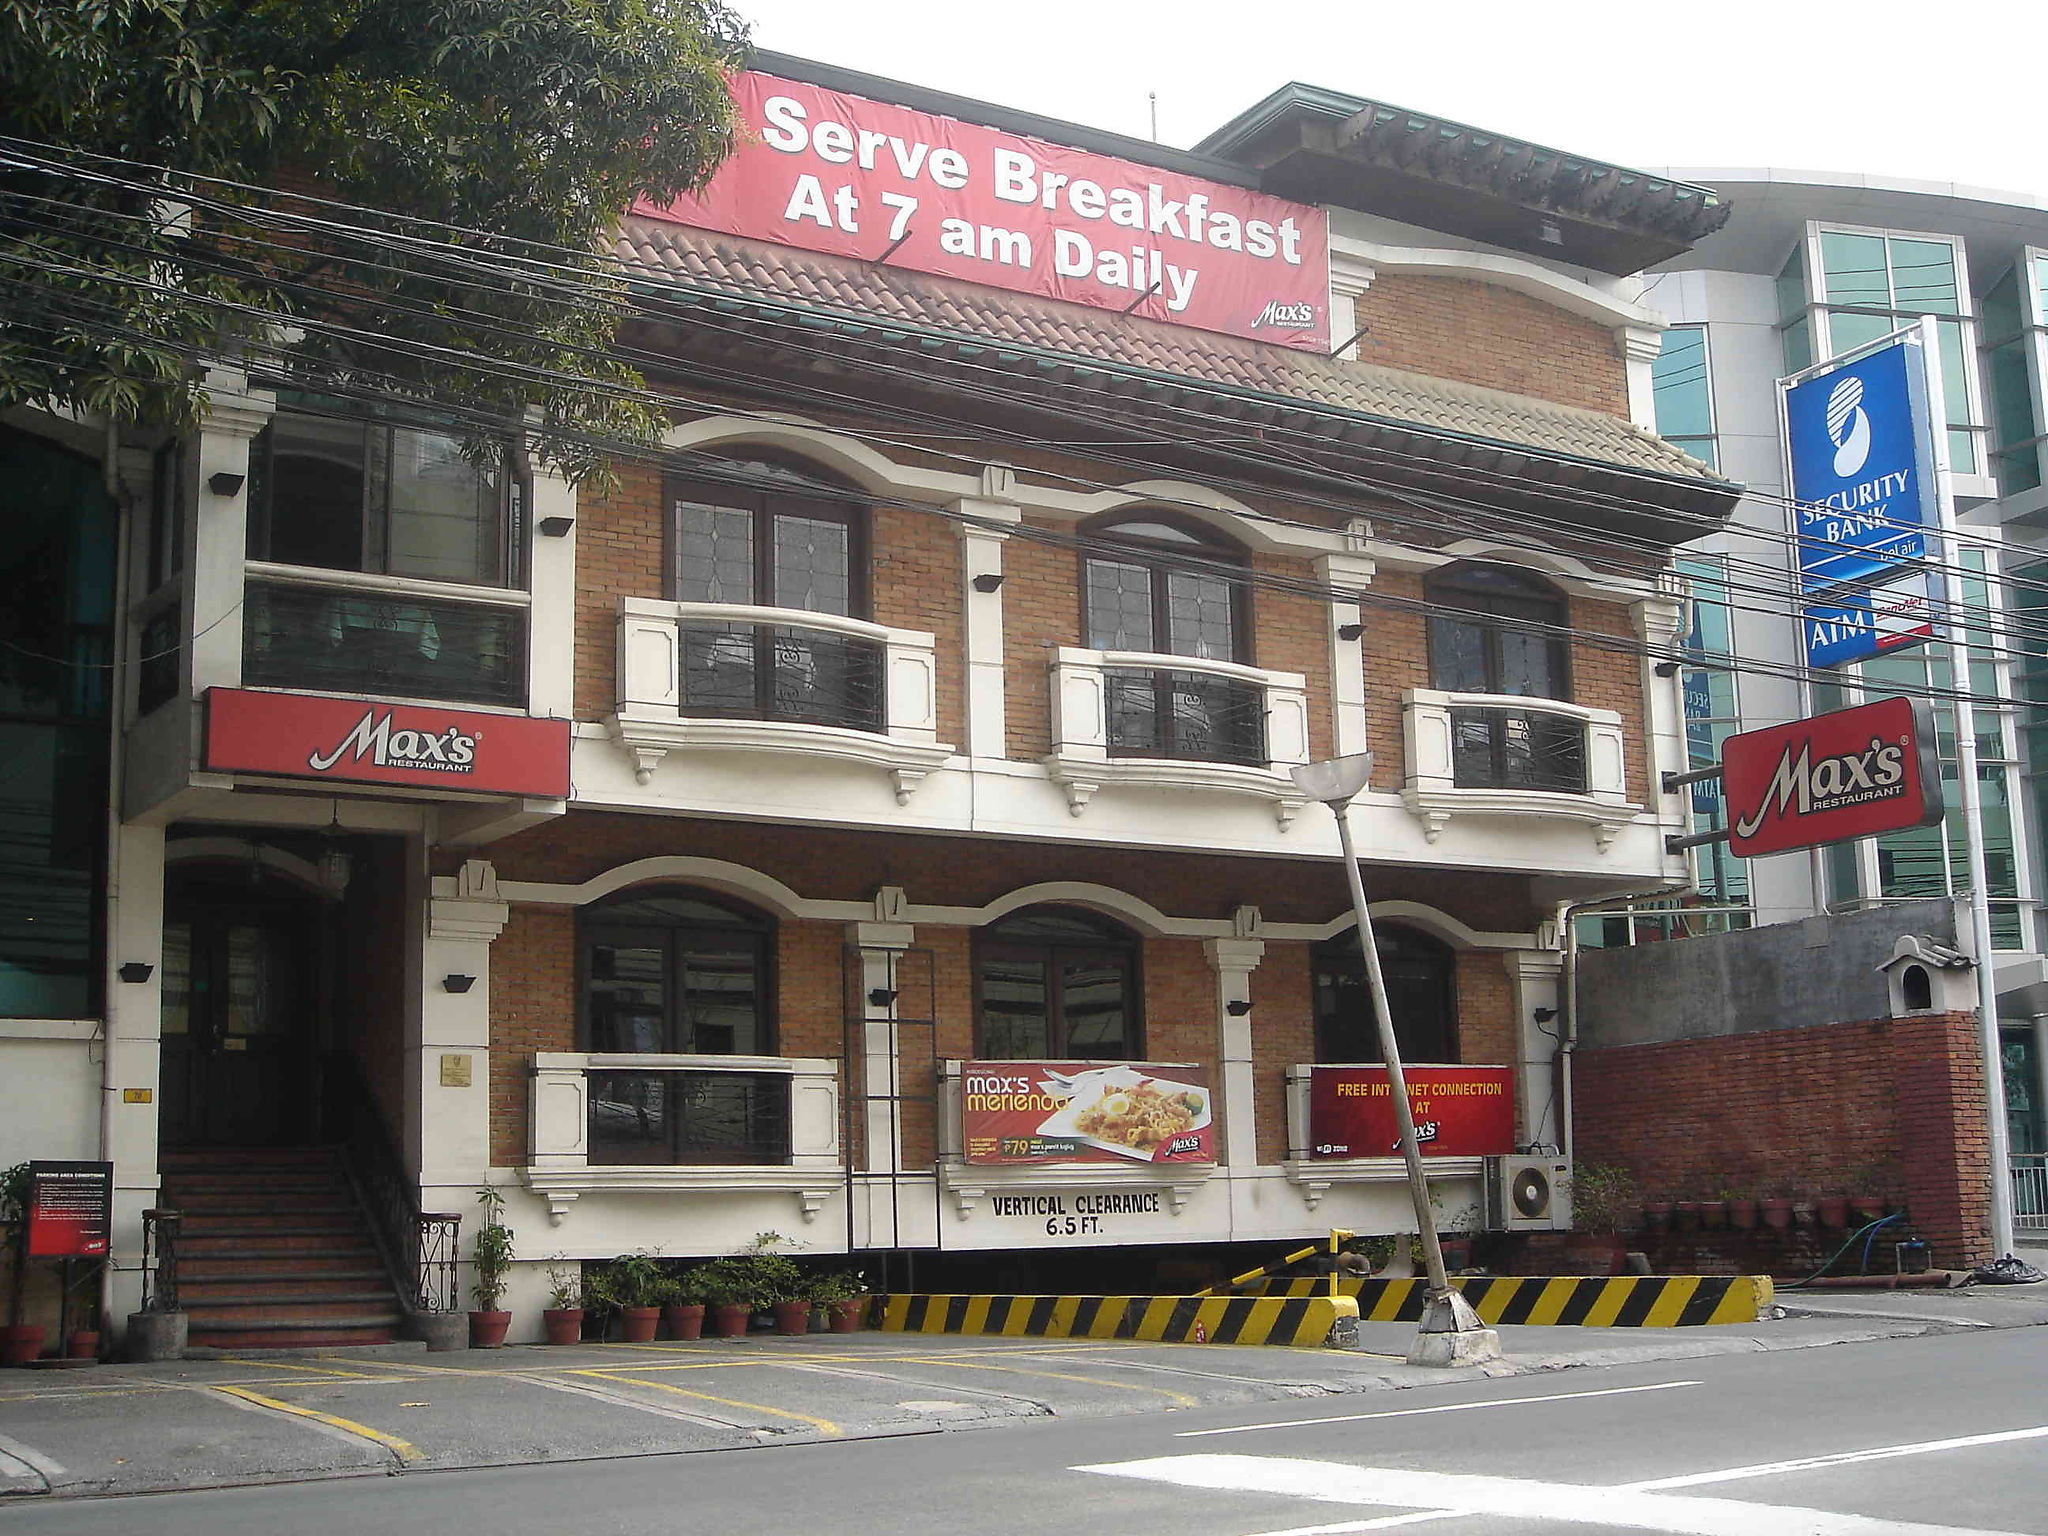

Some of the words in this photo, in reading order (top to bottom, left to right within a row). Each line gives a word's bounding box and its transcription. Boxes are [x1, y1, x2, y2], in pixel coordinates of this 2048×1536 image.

[761, 96, 970, 190] Serve
[993, 147, 1303, 266] Breakfast
[783, 174, 859, 233] At
[880, 191, 919, 241] 7
[939, 217, 1033, 268] am
[1054, 228, 1199, 312] Daily
[1250, 300, 1313, 328] Max's
[1803, 469, 1909, 525] SECURITY
[1826, 503, 1889, 543] BANK
[1901, 540, 1917, 556] air
[1811, 609, 1867, 650] ATM
[308, 711, 475, 770] Max's
[388, 758, 472, 773] RESTAURANT
[1736, 738, 1903, 838] Max's
[1813, 785, 1903, 811] RESTAURANT
[966, 1076, 1030, 1094] max's
[1337, 1082, 1368, 1097] FREE
[1371, 1083, 1429, 1097] INTNET
[1432, 1082, 1502, 1096] CONNECTION
[1415, 1101, 1431, 1114] AT
[1164, 1136, 1199, 1156] Max's
[991, 1195, 1066, 1216] VERTICAL
[1075, 1193, 1159, 1214] CLEARANCE
[1046, 1217, 1077, 1236] 6.5
[1081, 1216, 1104, 1234] FT.
